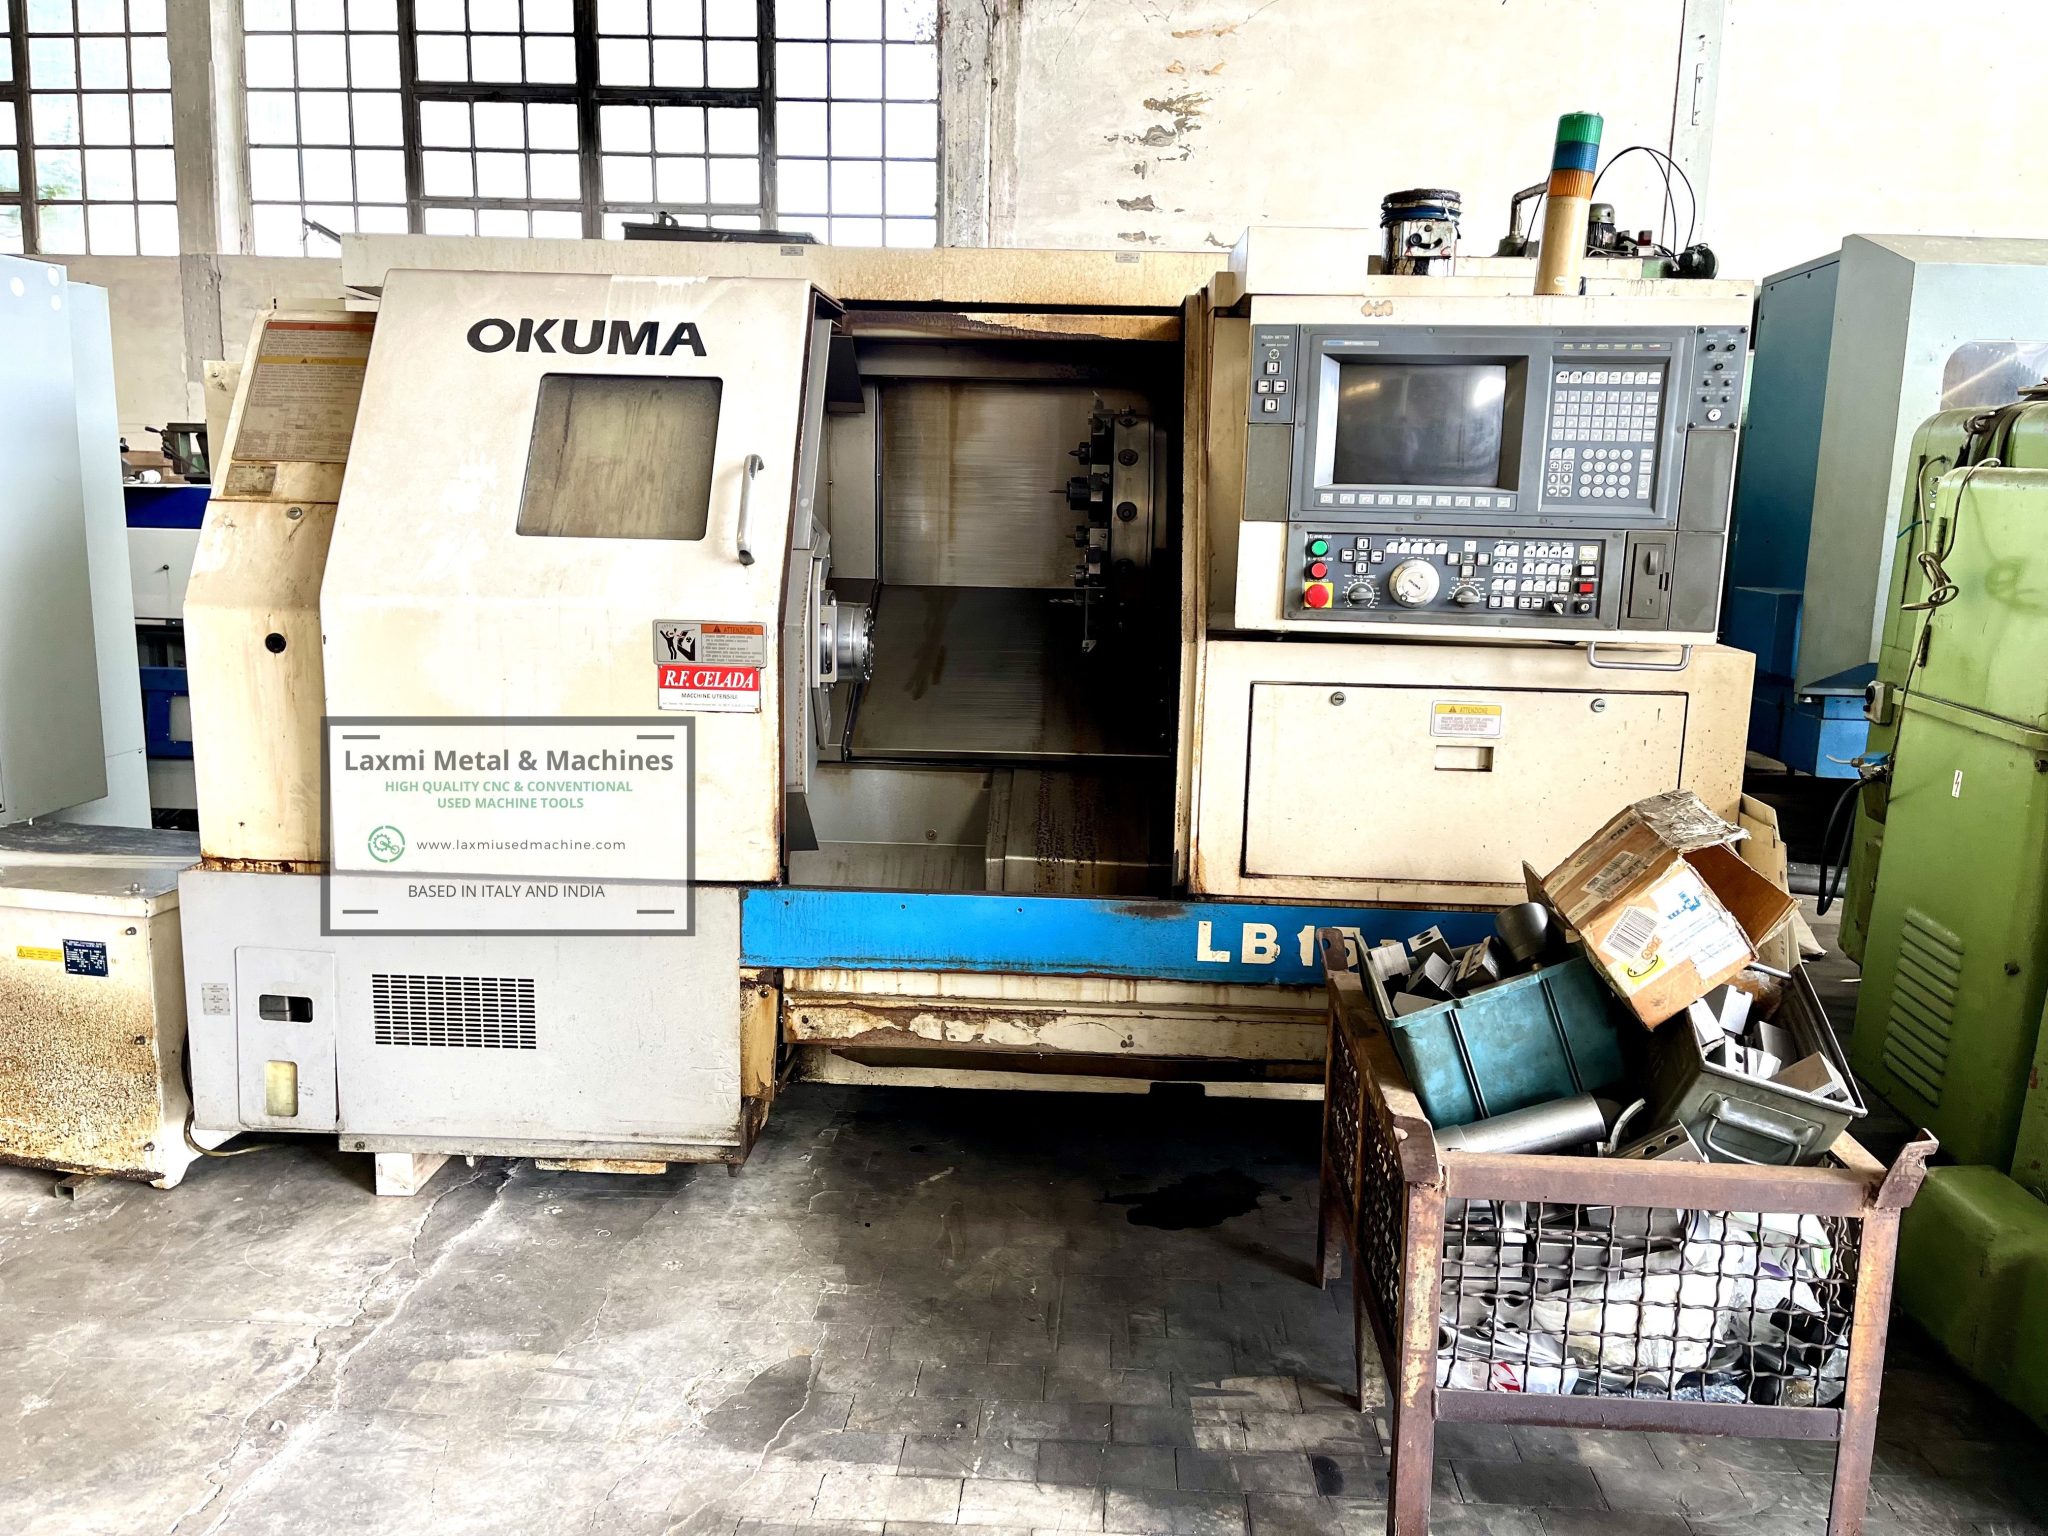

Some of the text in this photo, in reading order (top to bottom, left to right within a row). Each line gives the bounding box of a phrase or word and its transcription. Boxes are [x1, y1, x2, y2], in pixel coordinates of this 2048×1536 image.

[466, 317, 708, 357] OKUMA
[664, 670, 754, 689] R.F. CELADA
